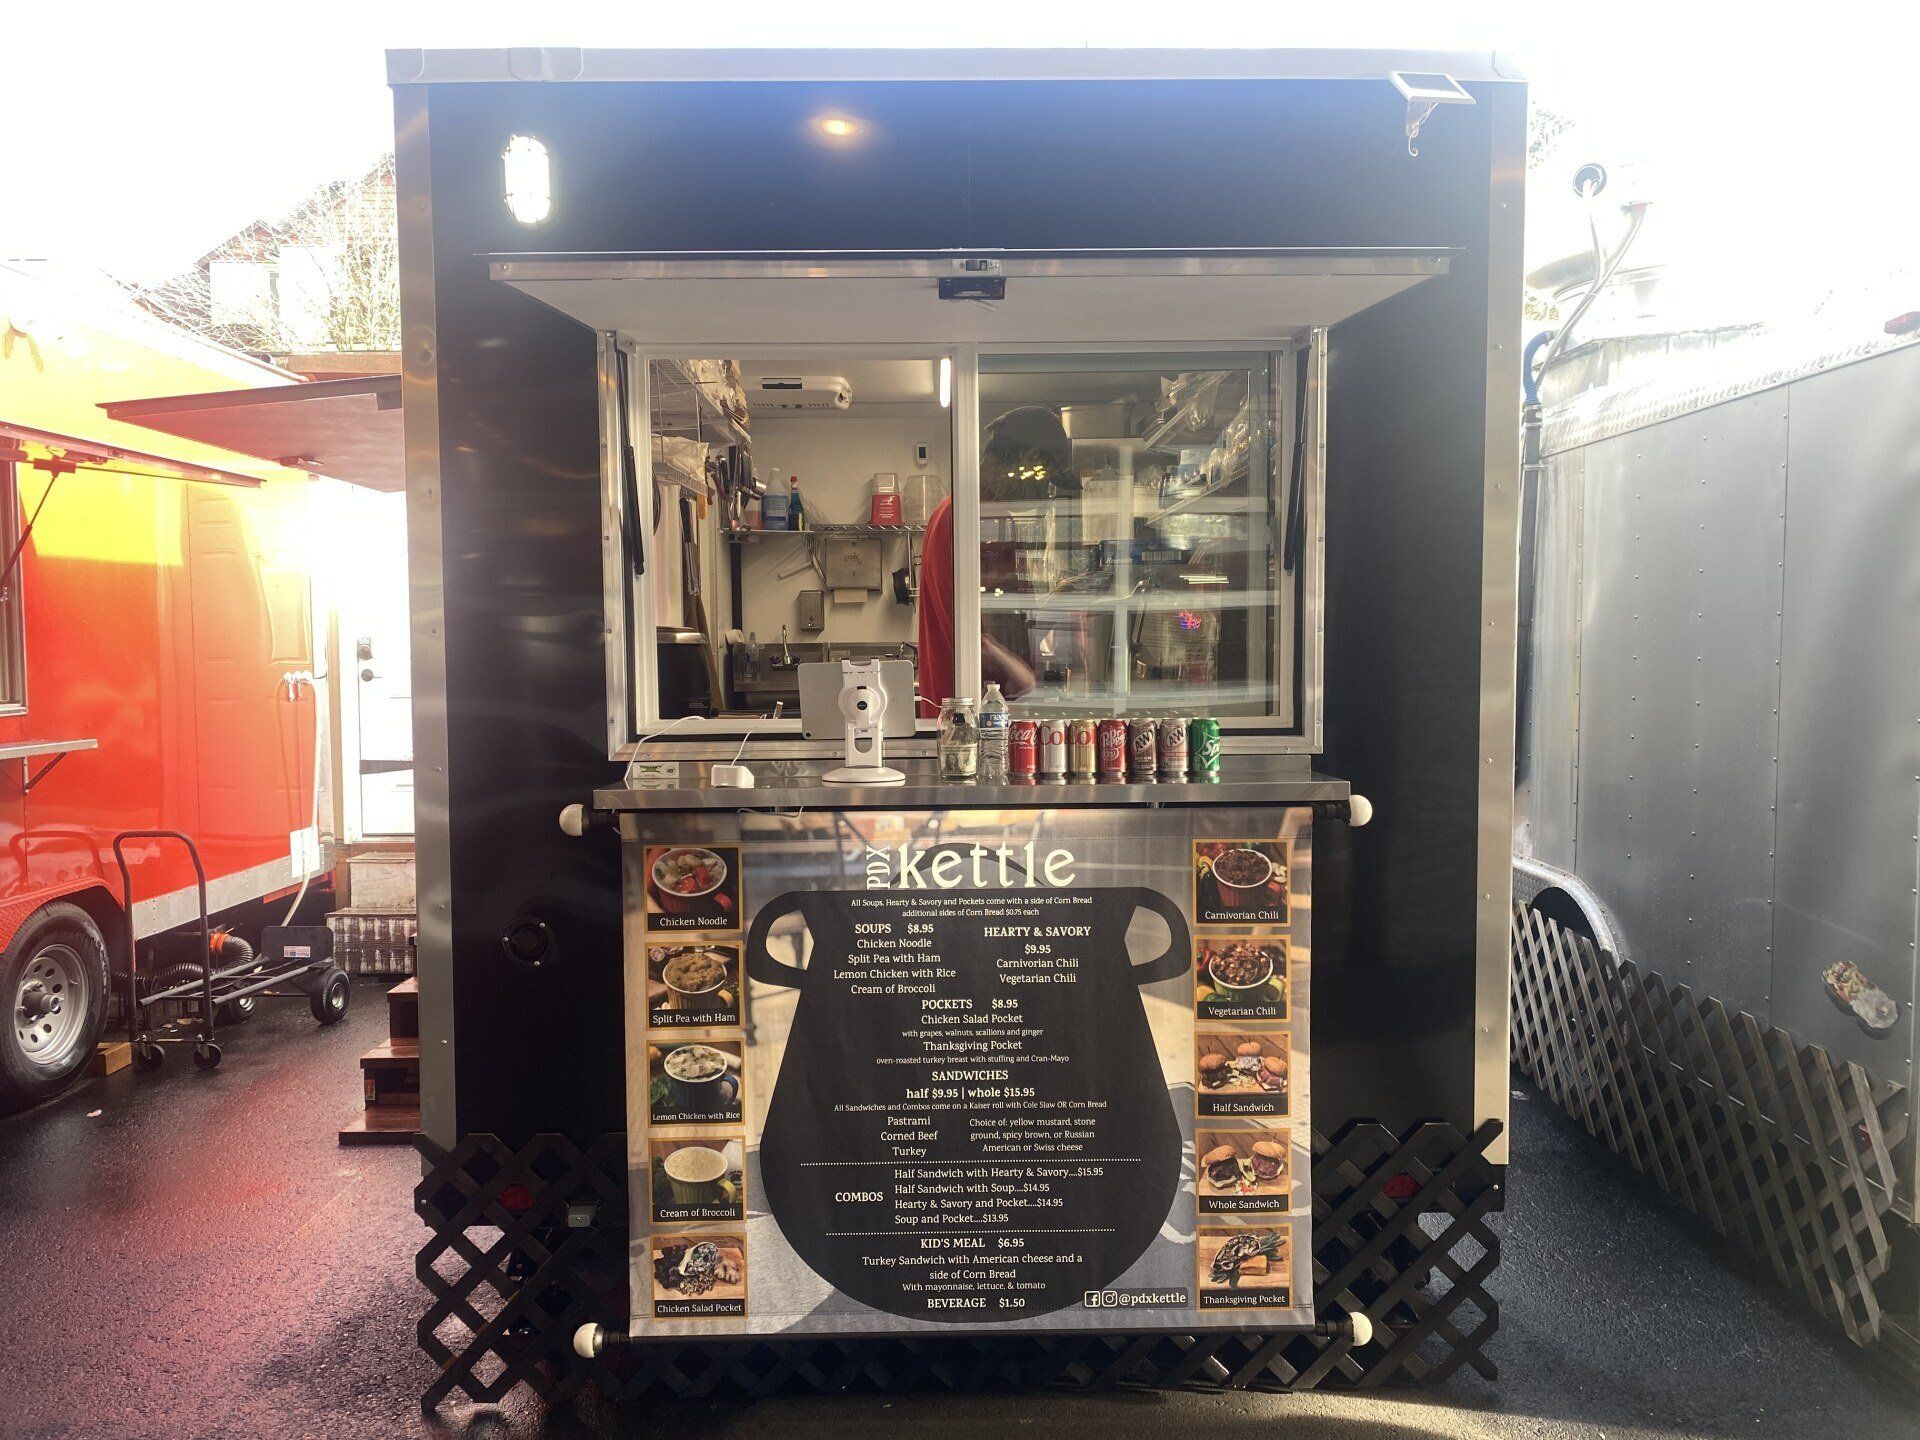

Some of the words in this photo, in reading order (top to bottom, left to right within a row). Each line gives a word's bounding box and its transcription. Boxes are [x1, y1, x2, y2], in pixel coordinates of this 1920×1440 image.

[866, 844, 891, 890] PDX
[897, 840, 1076, 889] kettle
[851, 899, 861, 907] All
[862, 899, 885, 908] Soups,
[886, 899, 910, 908] Hearty
[910, 898, 918, 906] &
[918, 898, 942, 907] Savory
[1006, 897, 1023, 905] with
[1030, 897, 1045, 905] side
[1045, 896, 1053, 905] of
[1072, 896, 1093, 904] Bread
[902, 909, 938, 917] additional
[938, 909, 957, 917] sides
[984, 908, 1005, 916] Bread
[1005, 908, 1022, 916] $0.75
[1022, 908, 1040, 916] each
[1204, 911, 1256, 920] Carnivorian
[1258, 910, 1279, 920] Chili
[659, 917, 695, 927] Chicken
[698, 916, 728, 926] Noodle
[855, 923, 892, 934] SOUPS
[907, 922, 934, 935] $8.95
[983, 926, 1031, 937] HEARTY
[1033, 927, 1043, 937] &
[1045, 926, 1092, 937] SAVORY
[857, 939, 897, 949] Chicken
[899, 938, 932, 948] Noodle
[1024, 943, 1051, 955] $9.95
[996, 958, 1054, 968] Carnivorian
[1056, 958, 1079, 968] Chili
[999, 973, 1051, 986] Vegetarian
[1053, 973, 1077, 983] Chili
[921, 998, 973, 1010] POCKETS
[991, 998, 1019, 1010] $8.95
[1208, 1007, 1254, 1018] Vegetarian
[1256, 1006, 1276, 1016] Chili
[652, 1014, 674, 1026] Split
[675, 1014, 691, 1023] Pea
[692, 1013, 712, 1023] with
[714, 1013, 736, 1022] Ham
[919, 1030, 944, 1039] grapes,
[944, 1029, 975, 1037] walnuts,
[975, 1028, 1006, 1036] scallions
[1006, 1028, 1021, 1036] and
[1021, 1029, 1044, 1037] ginger
[923, 1041, 989, 1053] Thanksgiving
[990, 1040, 1023, 1050] Pocket
[876, 1056, 922, 1065] oven-roasted
[922, 1056, 946, 1065] turkey
[947, 1056, 969, 1064] breast
[970, 1055, 987, 1063] with
[987, 1055, 1015, 1064] stuffing
[1030, 1054, 1070, 1064] Cran-Mayo
[931, 1070, 1009, 1081] SANDWICHES
[906, 1088, 930, 1099] half
[932, 1088, 959, 1100] $9.95
[967, 1087, 1001, 1098] whole
[1004, 1086, 1035, 1099] $15.95
[834, 1104, 844, 1112] All
[845, 1104, 887, 1112] Sandwiches
[887, 1103, 901, 1111] and
[902, 1103, 931, 1111] Combos
[969, 1102, 991, 1110] Kaiser
[992, 1101, 1004, 1109] roll
[1005, 1101, 1022, 1109] with
[1022, 1101, 1038, 1109] Cole
[1039, 1101, 1056, 1109] Slaw
[1056, 1101, 1068, 1109] OR
[1068, 1101, 1086, 1109] Corn
[1087, 1100, 1107, 1108] Bread
[1213, 1103, 1232, 1112] Half
[1233, 1102, 1275, 1112] Sandwich
[678, 1112, 707, 1120] Chicken
[707, 1112, 724, 1120] with
[725, 1111, 741, 1119] Rice
[887, 1116, 931, 1126] Pastrami
[969, 1118, 997, 1127] Choice
[997, 1118, 1008, 1127] of:
[1009, 1118, 1035, 1128] yellow
[1036, 1117, 1073, 1126] mustard,
[1074, 1118, 1096, 1126] stone
[880, 1131, 916, 1141] Corned
[918, 1130, 939, 1141] Beef
[970, 1131, 1001, 1142] ground,
[1002, 1131, 1023, 1141] spicy
[1024, 1130, 1052, 1139] brown,
[1064, 1130, 1095, 1139] Russian
[892, 1146, 927, 1158] Turkey
[982, 1144, 1022, 1152] American
[1033, 1143, 1056, 1152] Swiss
[1056, 1143, 1083, 1152] cheese
[835, 1191, 884, 1203] COMBOS
[1208, 1200, 1237, 1209] Whole
[1238, 1199, 1280, 1209] Sandwich
[660, 1209, 689, 1218] Cream
[690, 1208, 700, 1217] of
[702, 1208, 736, 1217] Broccoli
[920, 1238, 951, 1249] KID'S
[953, 1238, 986, 1248] MEAL
[997, 1237, 1025, 1249] $6.95
[861, 1256, 897, 1268] Turkey
[898, 1255, 946, 1265] Sandwich
[947, 1254, 970, 1264] with
[972, 1254, 1020, 1264] American
[1021, 1253, 1054, 1263] cheese
[1056, 1253, 1075, 1263] and
[1077, 1255, 1083, 1263] a
[929, 1270, 949, 1280] side
[950, 1269, 961, 1279] of
[962, 1269, 987, 1279] Corn
[989, 1269, 1016, 1279] Bread
[902, 1283, 923, 1292] With
[924, 1283, 975, 1293] mayonnaise,
[976, 1282, 1006, 1290] lettuce,
[1007, 1281, 1015, 1290] &
[1016, 1282, 1046, 1290] tomato
[927, 1297, 987, 1309] BEVERAGE
[999, 1297, 1026, 1308] $1.50
[1118, 1292, 1186, 1307] @pdxkettle
[1203, 1295, 1258, 1306] Thanksgiving
[1259, 1294, 1286, 1303] Pocket
[657, 1305, 690, 1313] Chicken
[691, 1304, 714, 1313] Salad
[715, 1303, 742, 1312] Pocket
